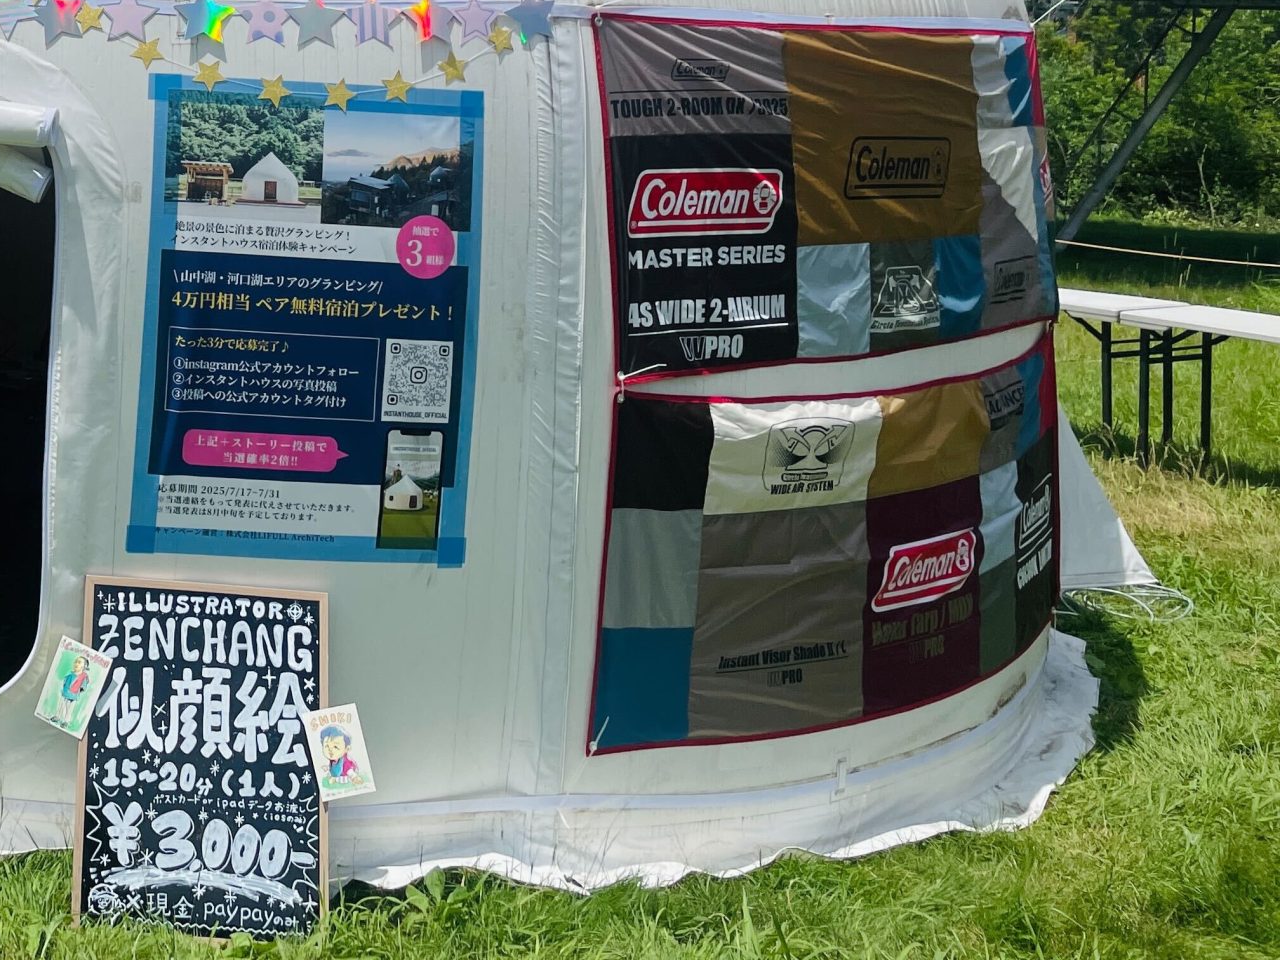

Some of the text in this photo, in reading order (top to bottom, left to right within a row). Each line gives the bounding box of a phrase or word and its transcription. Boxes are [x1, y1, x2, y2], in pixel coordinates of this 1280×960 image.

[611, 98, 663, 119] TOUGH
[856, 146, 930, 182] Coleman
[641, 179, 749, 219] Coleman
[406, 240, 423, 266] 3
[629, 245, 786, 270] MASTER SERIES
[172, 291, 250, 312] 4万円相当
[628, 302, 653, 328] 4S
[655, 299, 706, 326] WIDE
[888, 551, 954, 590] Coleman
[118, 592, 283, 620] ILLUSTRATOR
[98, 614, 313, 673] ZENCHANG
[719, 652, 760, 670] Instant
[762, 648, 792, 665] Visor
[793, 643, 826, 660] Shade
[96, 667, 310, 768] 似顔絵
